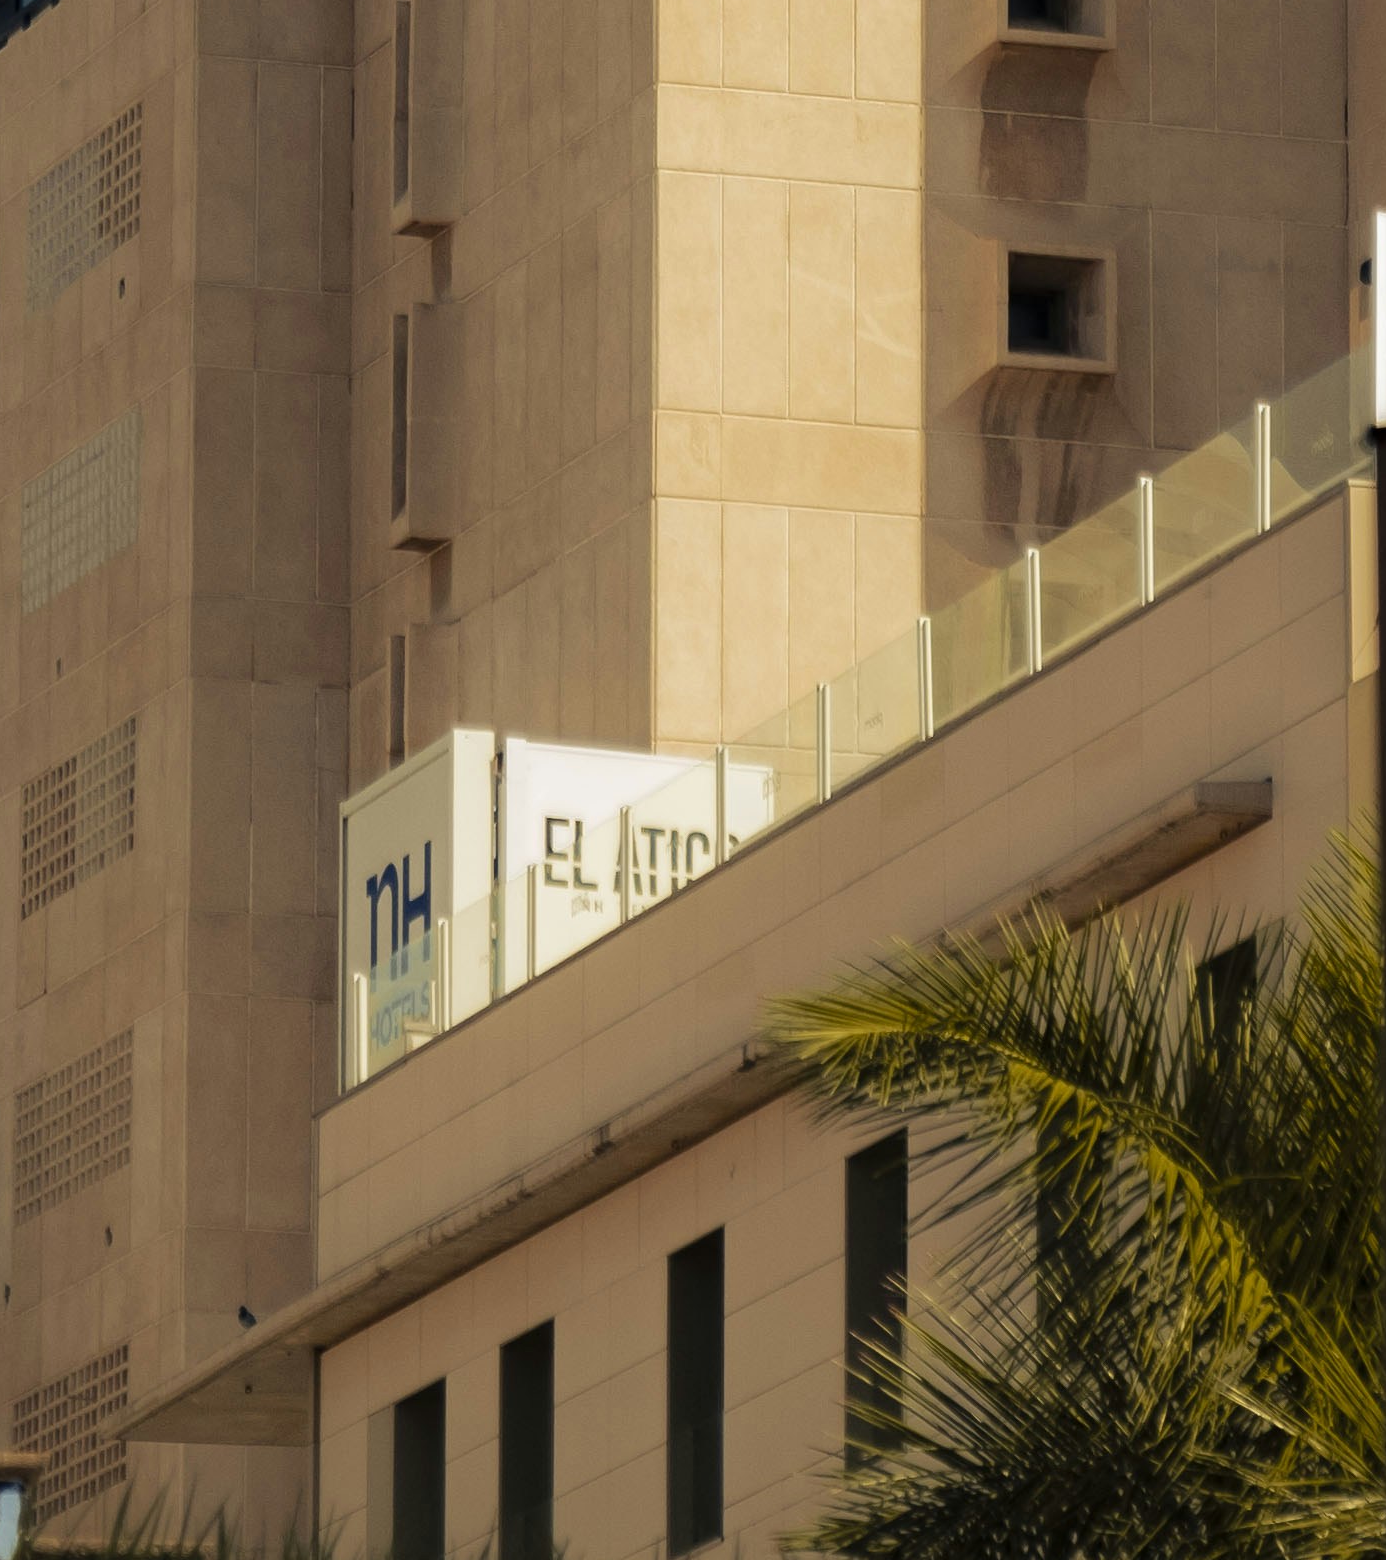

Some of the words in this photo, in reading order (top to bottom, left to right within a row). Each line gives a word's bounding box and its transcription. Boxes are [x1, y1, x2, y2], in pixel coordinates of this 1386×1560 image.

[544, 817, 598, 890] EL
[612, 826, 739, 896] ATIC
[371, 980, 430, 1049] HOTELS
